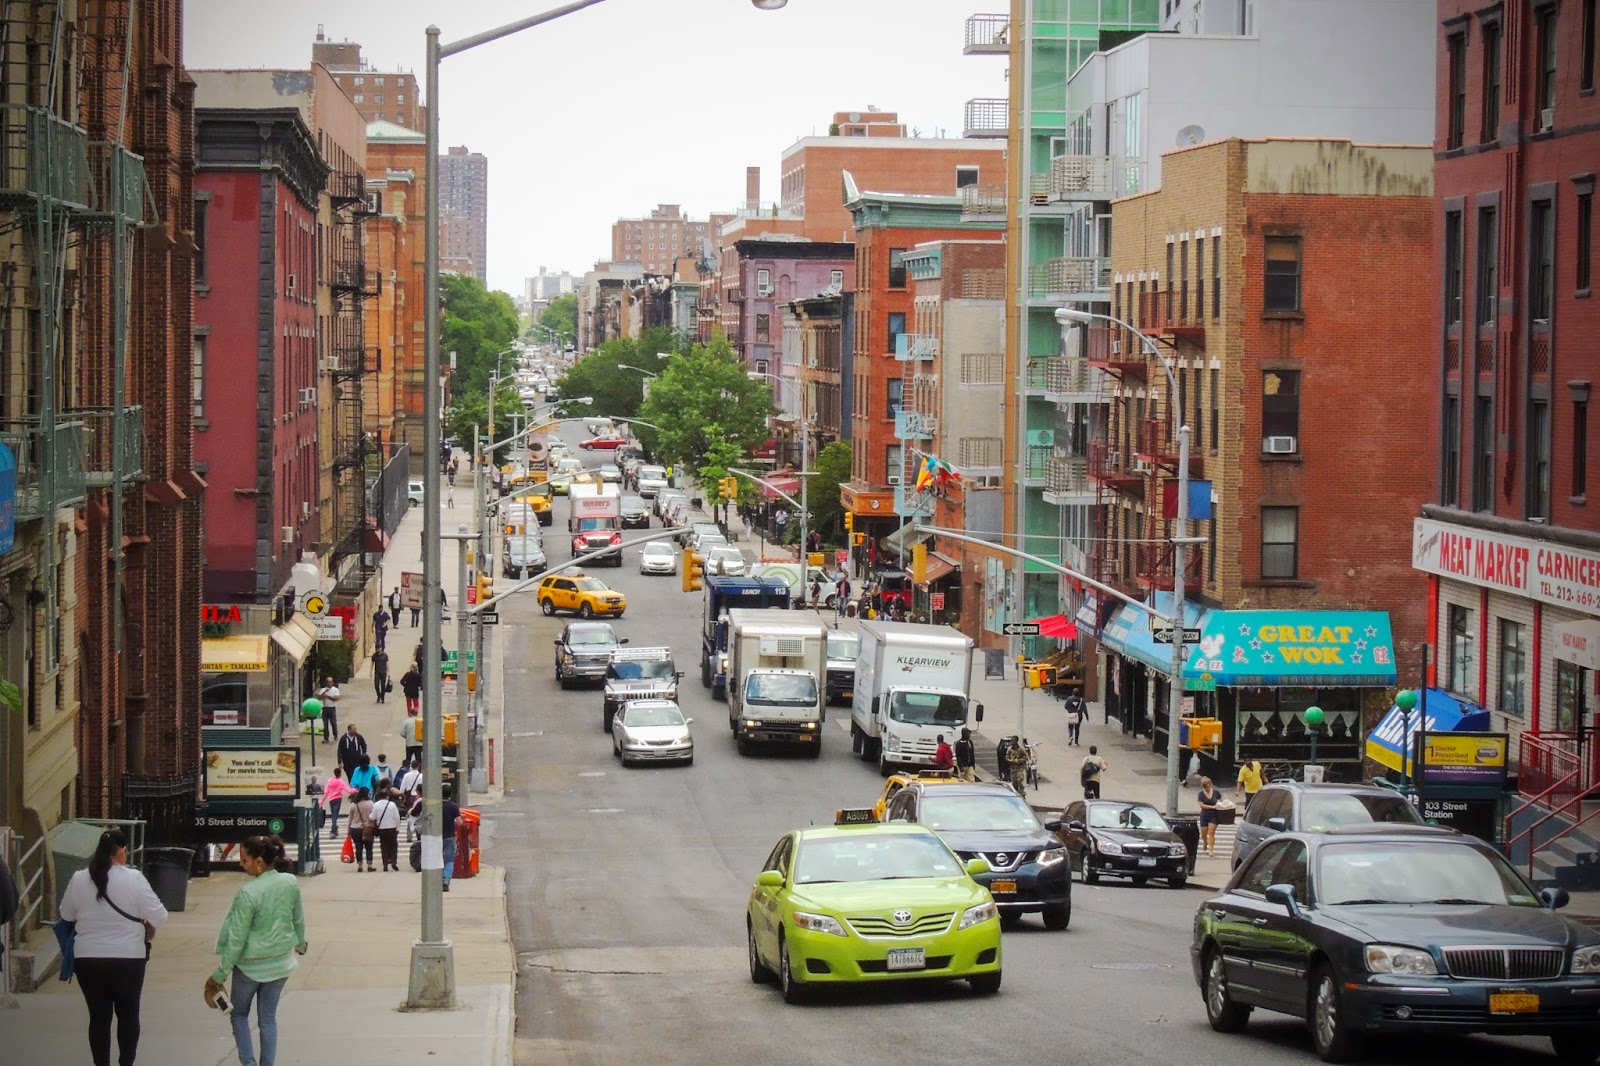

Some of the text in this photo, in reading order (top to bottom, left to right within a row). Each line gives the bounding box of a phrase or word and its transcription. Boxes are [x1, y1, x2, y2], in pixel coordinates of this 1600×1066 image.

[1439, 531, 1472, 577] MEAT
[1474, 539, 1530, 590] MARKET
[1541, 582, 1554, 597] TEL.
[1258, 625, 1353, 643] GREAT
[897, 656, 951, 667] KLEARVIEW
[1232, 646, 1249, 664] 大
[1278, 646, 1344, 664] WOK
[1373, 646, 1391, 664] 旺
[1425, 802, 1467, 810] 103 Street
[195, 818, 267, 826] 03 Street Station
[1424, 810, 1453, 819] Station
